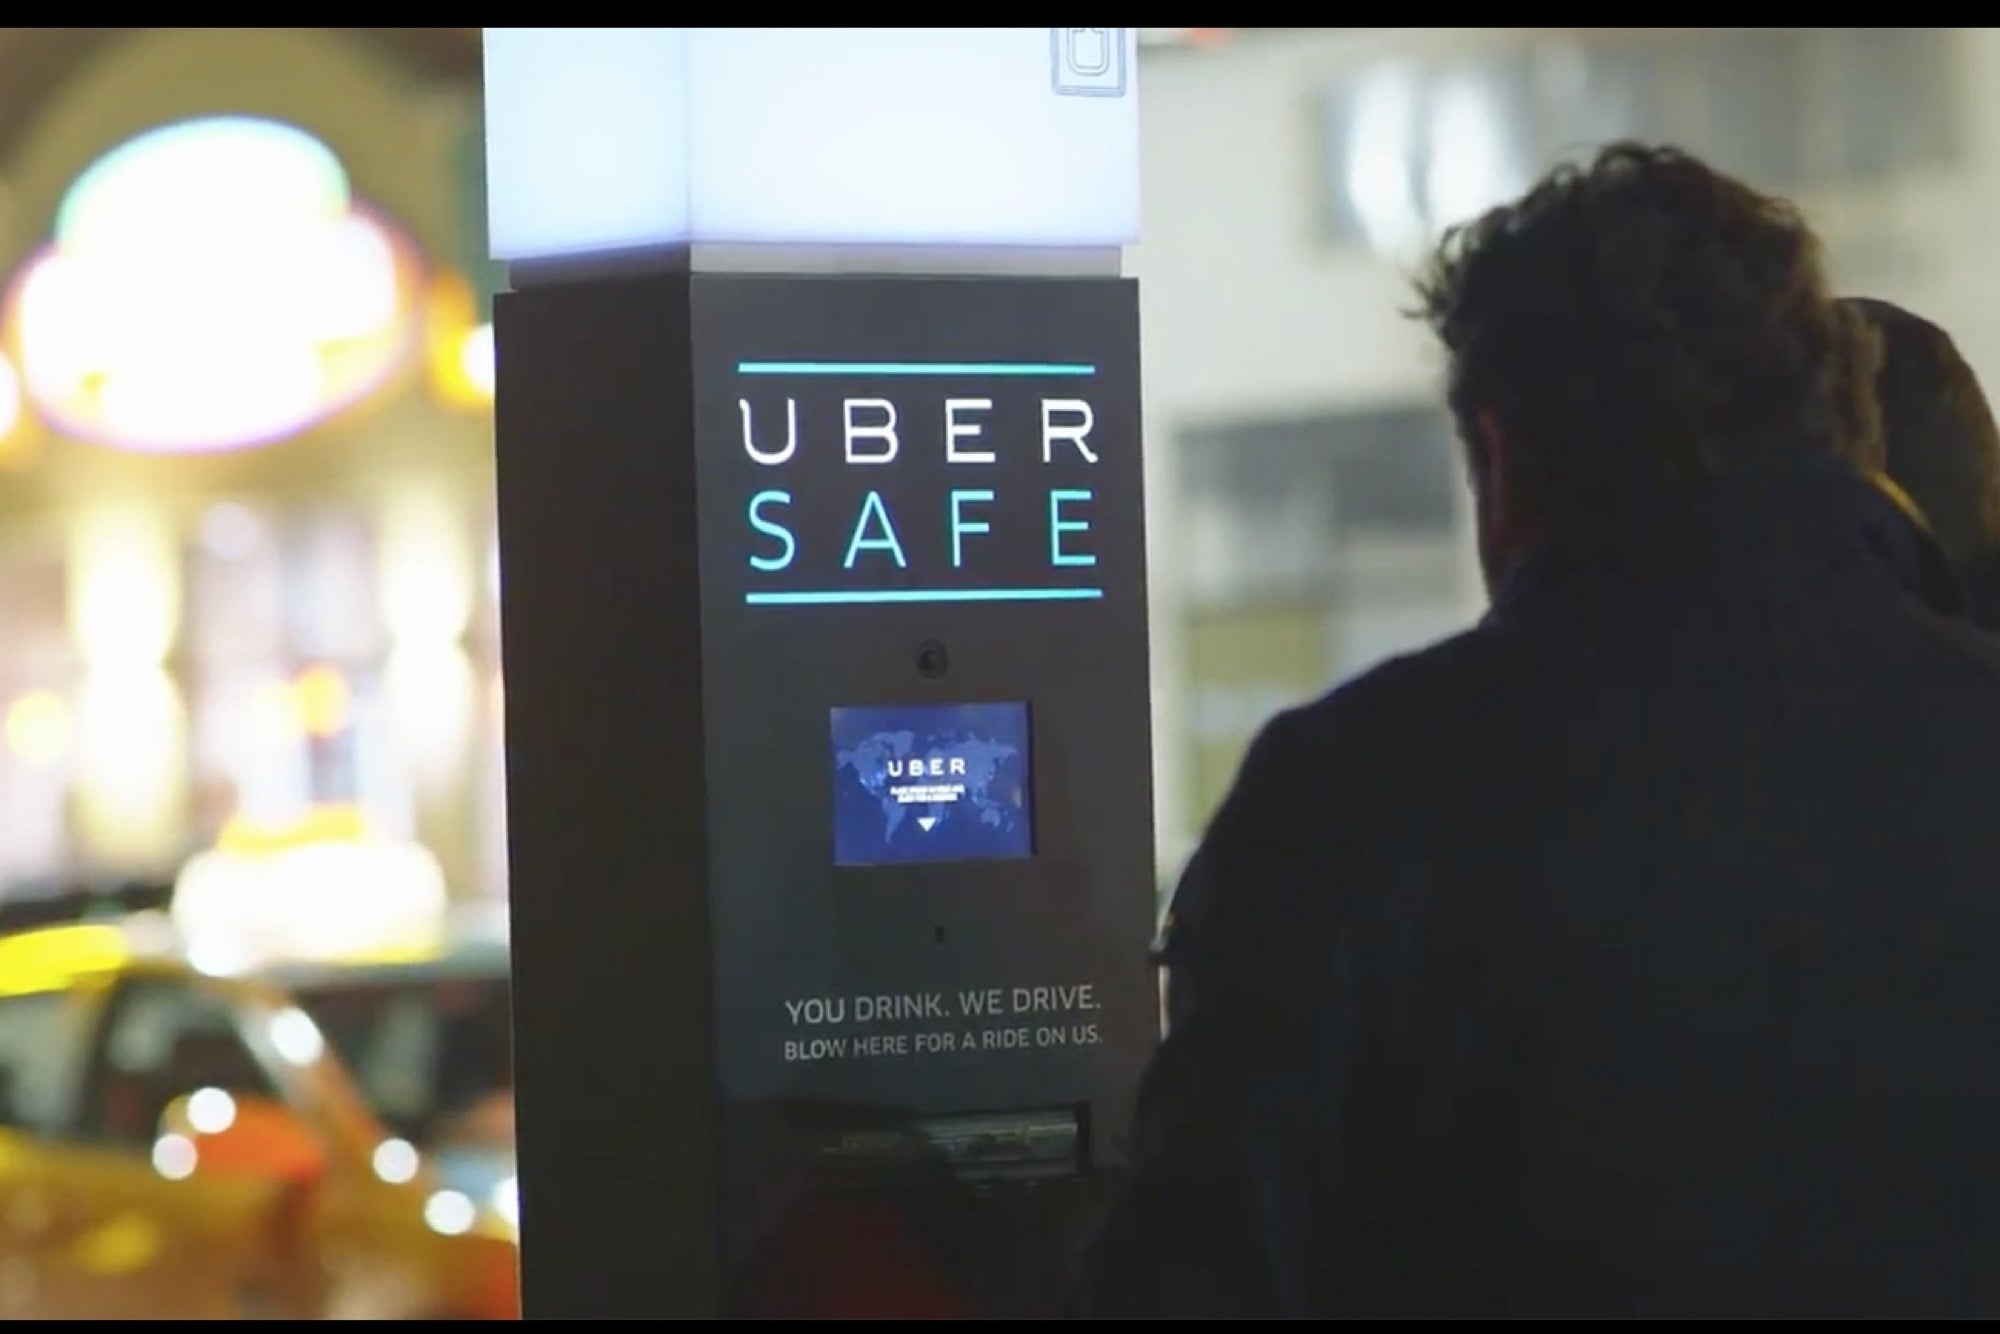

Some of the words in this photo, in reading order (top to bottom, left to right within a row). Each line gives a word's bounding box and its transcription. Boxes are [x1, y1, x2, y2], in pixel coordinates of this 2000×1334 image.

[739, 397, 1099, 465] UBER
[748, 490, 1096, 571] SAFE
[887, 758, 966, 777] UBER
[785, 998, 845, 1026] YOU
[854, 993, 950, 1022] DRINK.
[959, 989, 1003, 1016] WE
[1012, 984, 1101, 1013] DRIVE.
[784, 1038, 846, 1061] BLOW
[854, 1034, 908, 1056] HERE
[915, 1031, 955, 1052] FOR
[961, 1030, 977, 1049] A
[982, 1027, 1030, 1048] RIDE
[1036, 1026, 1067, 1047] ON
[1072, 1024, 1103, 1045] US.
